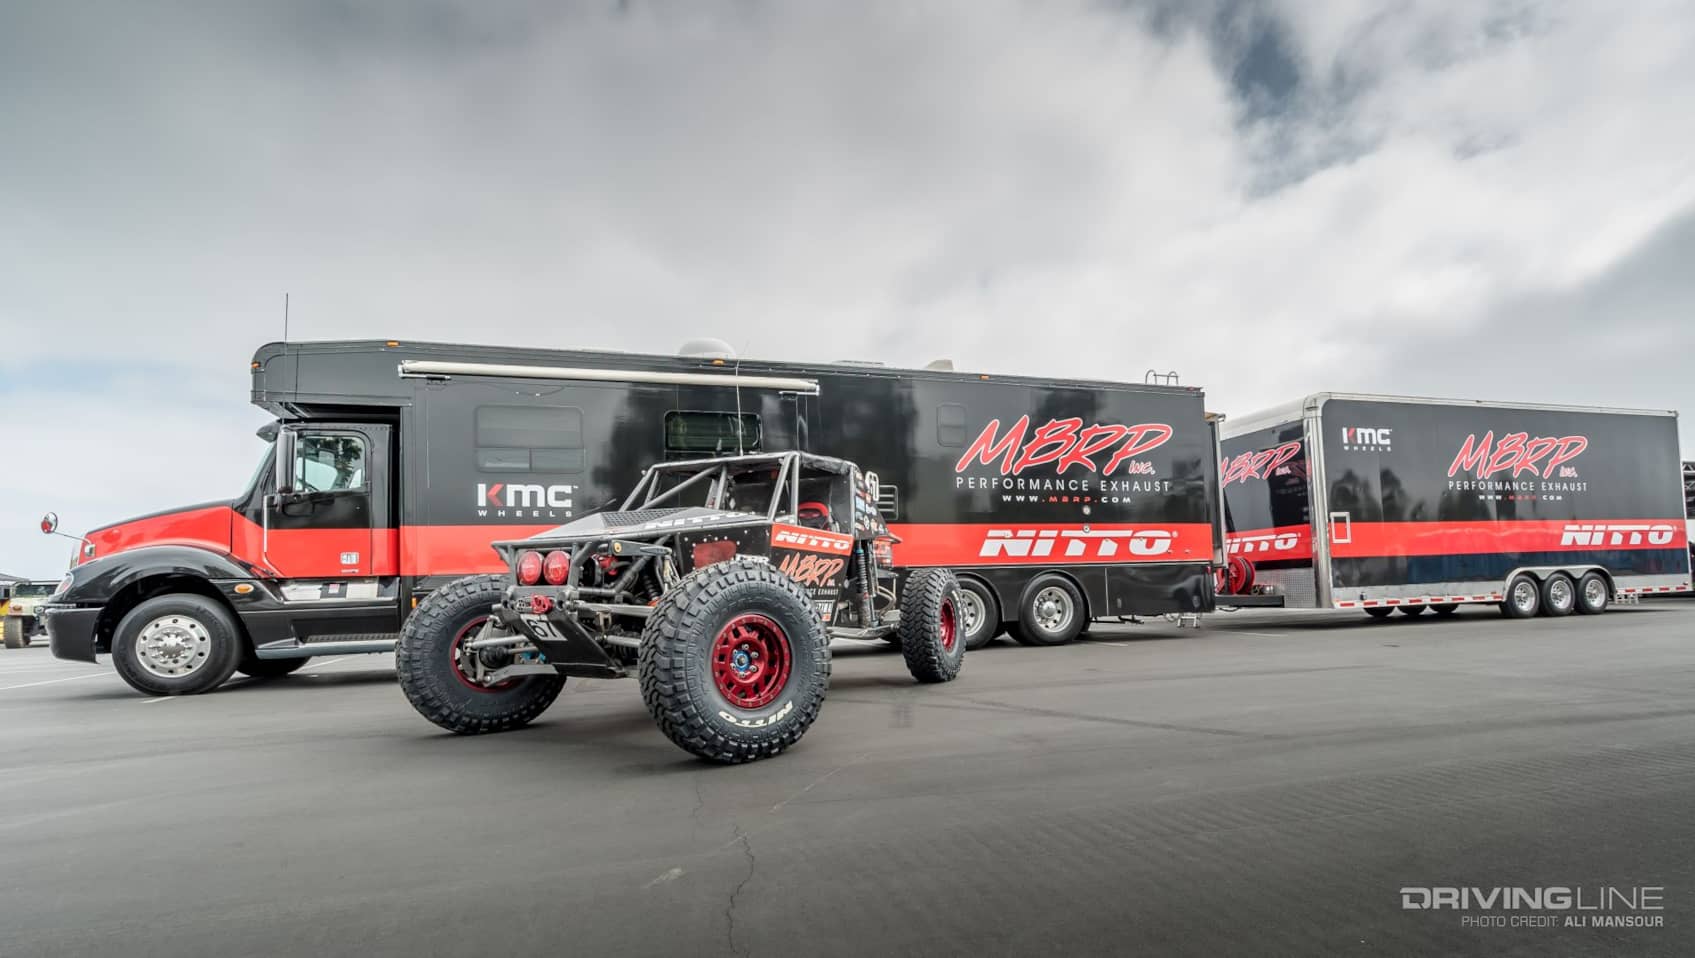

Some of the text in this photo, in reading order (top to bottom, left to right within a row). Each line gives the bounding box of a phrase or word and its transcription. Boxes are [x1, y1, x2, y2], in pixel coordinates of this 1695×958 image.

[955, 415, 1173, 476] MBRP
[1448, 430, 1588, 479] MBRP
[956, 477, 1169, 492] PERFORMANCE EXHAUST
[1448, 481, 1587, 491] PERFORMANCE EXHAUST
[1002, 495, 1131, 503] WWW.MBRP.COM
[478, 509, 572, 517] WHEELS
[775, 531, 850, 550] NITTO
[978, 530, 1172, 556] NITTO
[1560, 525, 1674, 545] NITTO
[526, 619, 557, 637] 67
[718, 700, 793, 728] NITTO
